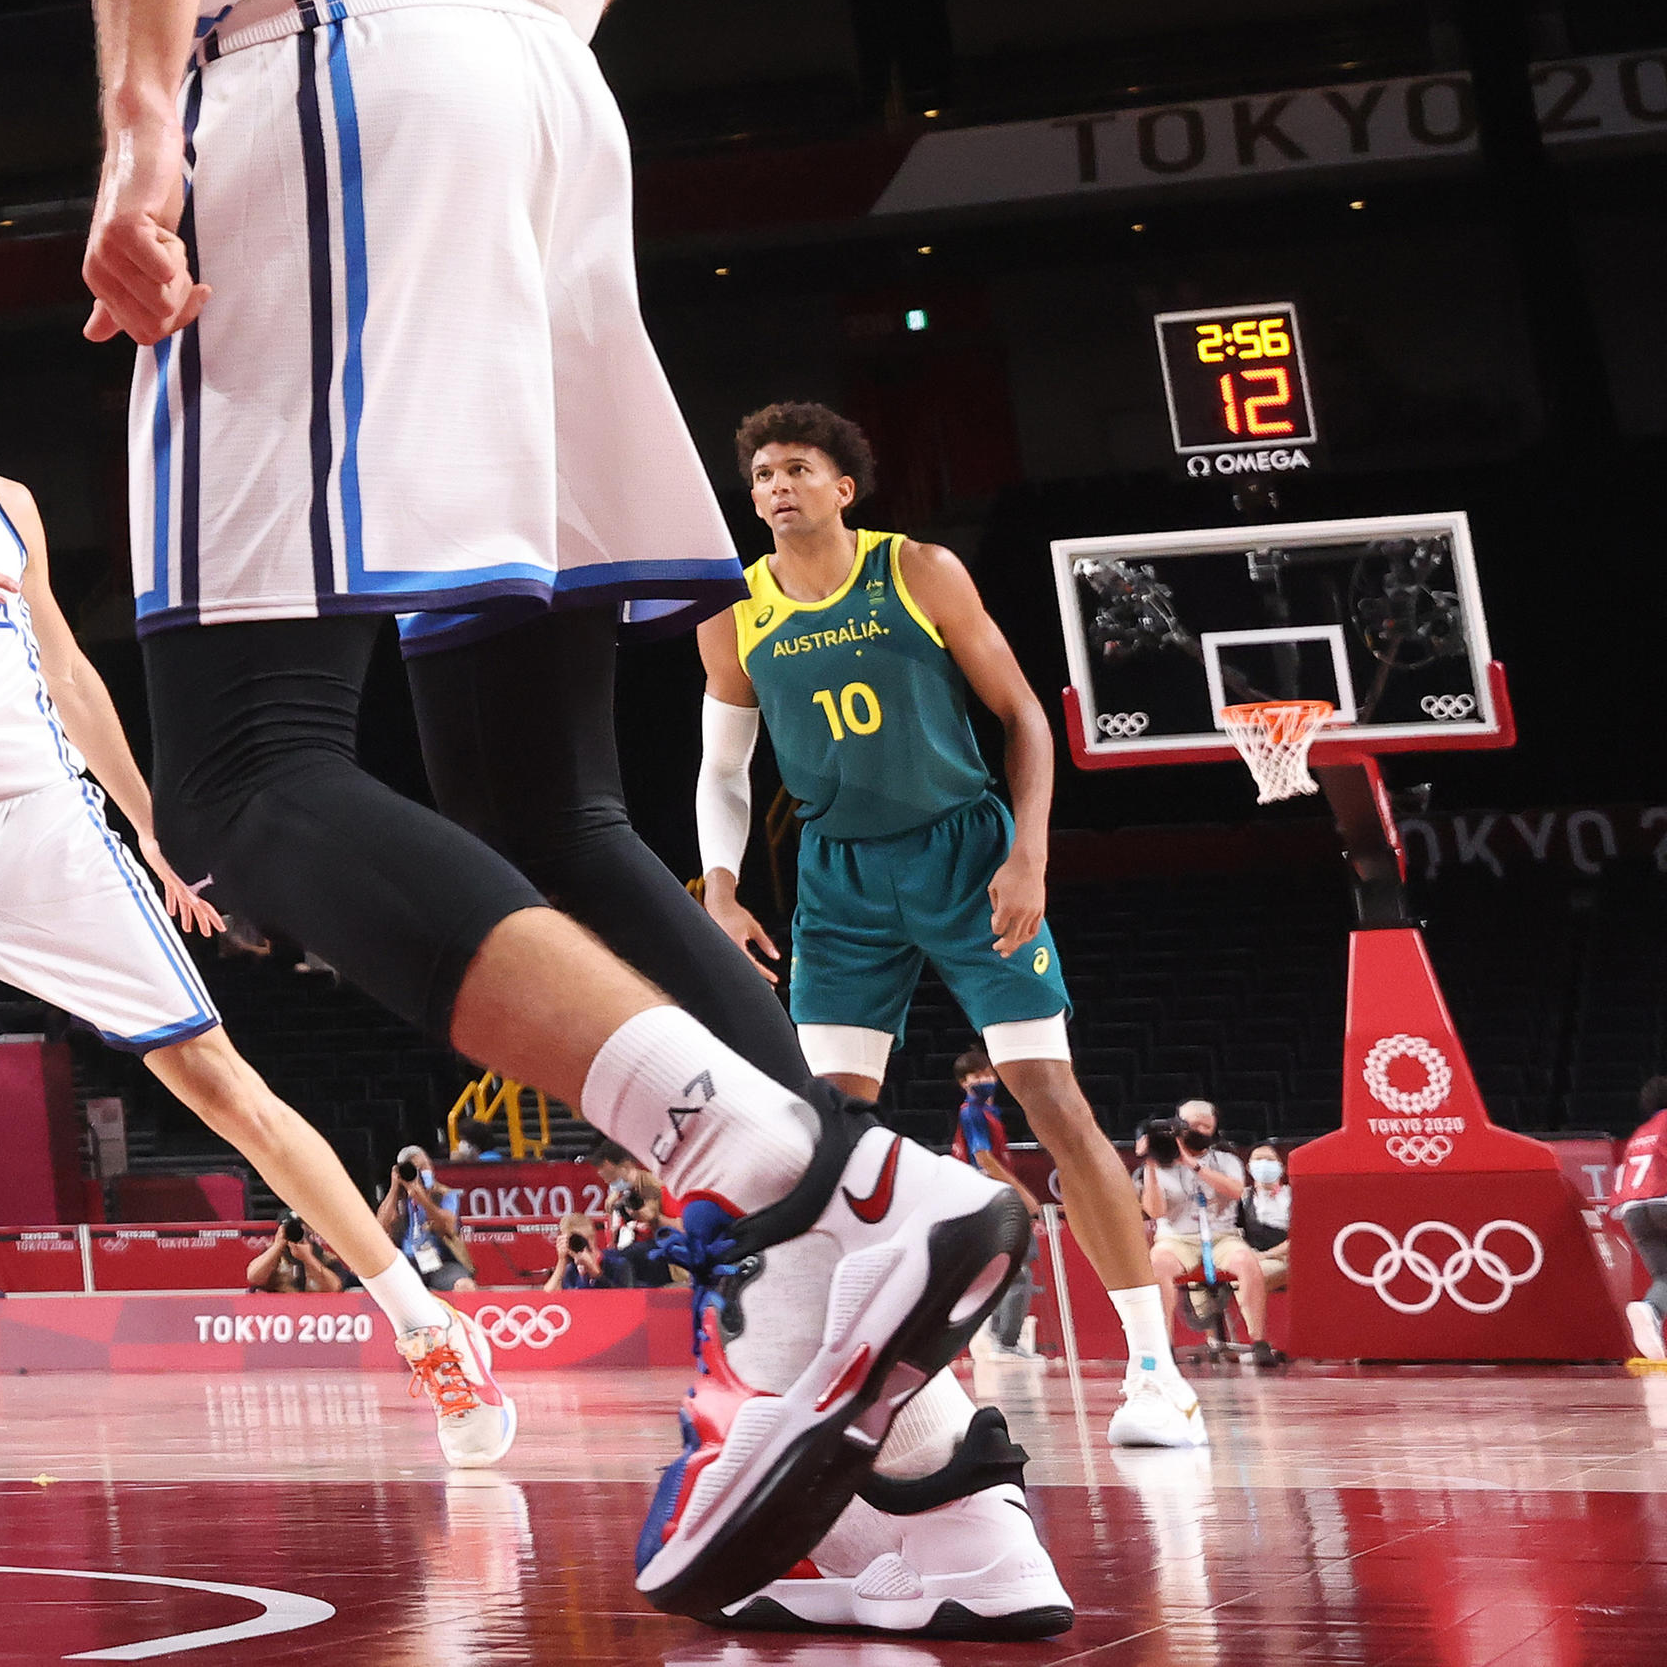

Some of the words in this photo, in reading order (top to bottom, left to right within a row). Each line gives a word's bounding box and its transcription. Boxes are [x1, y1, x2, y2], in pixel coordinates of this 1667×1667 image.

[1052, 78, 1477, 184] TOKYO
[1195, 317, 1292, 364] 2:56
[1219, 365, 1296, 436] 12
[1214, 448, 1311, 475] OMEGA
[772, 619, 883, 659] AUSTRALIA
[811, 681, 884, 742] 10
[1400, 808, 1618, 878] OKYO
[1367, 1117, 1423, 1136] TOKYO
[1424, 1116, 1466, 1135] 2020
[455, 1185, 575, 1218] OKYO
[194, 1314, 295, 1344] TOKYO
[297, 1314, 374, 1344] 2020
